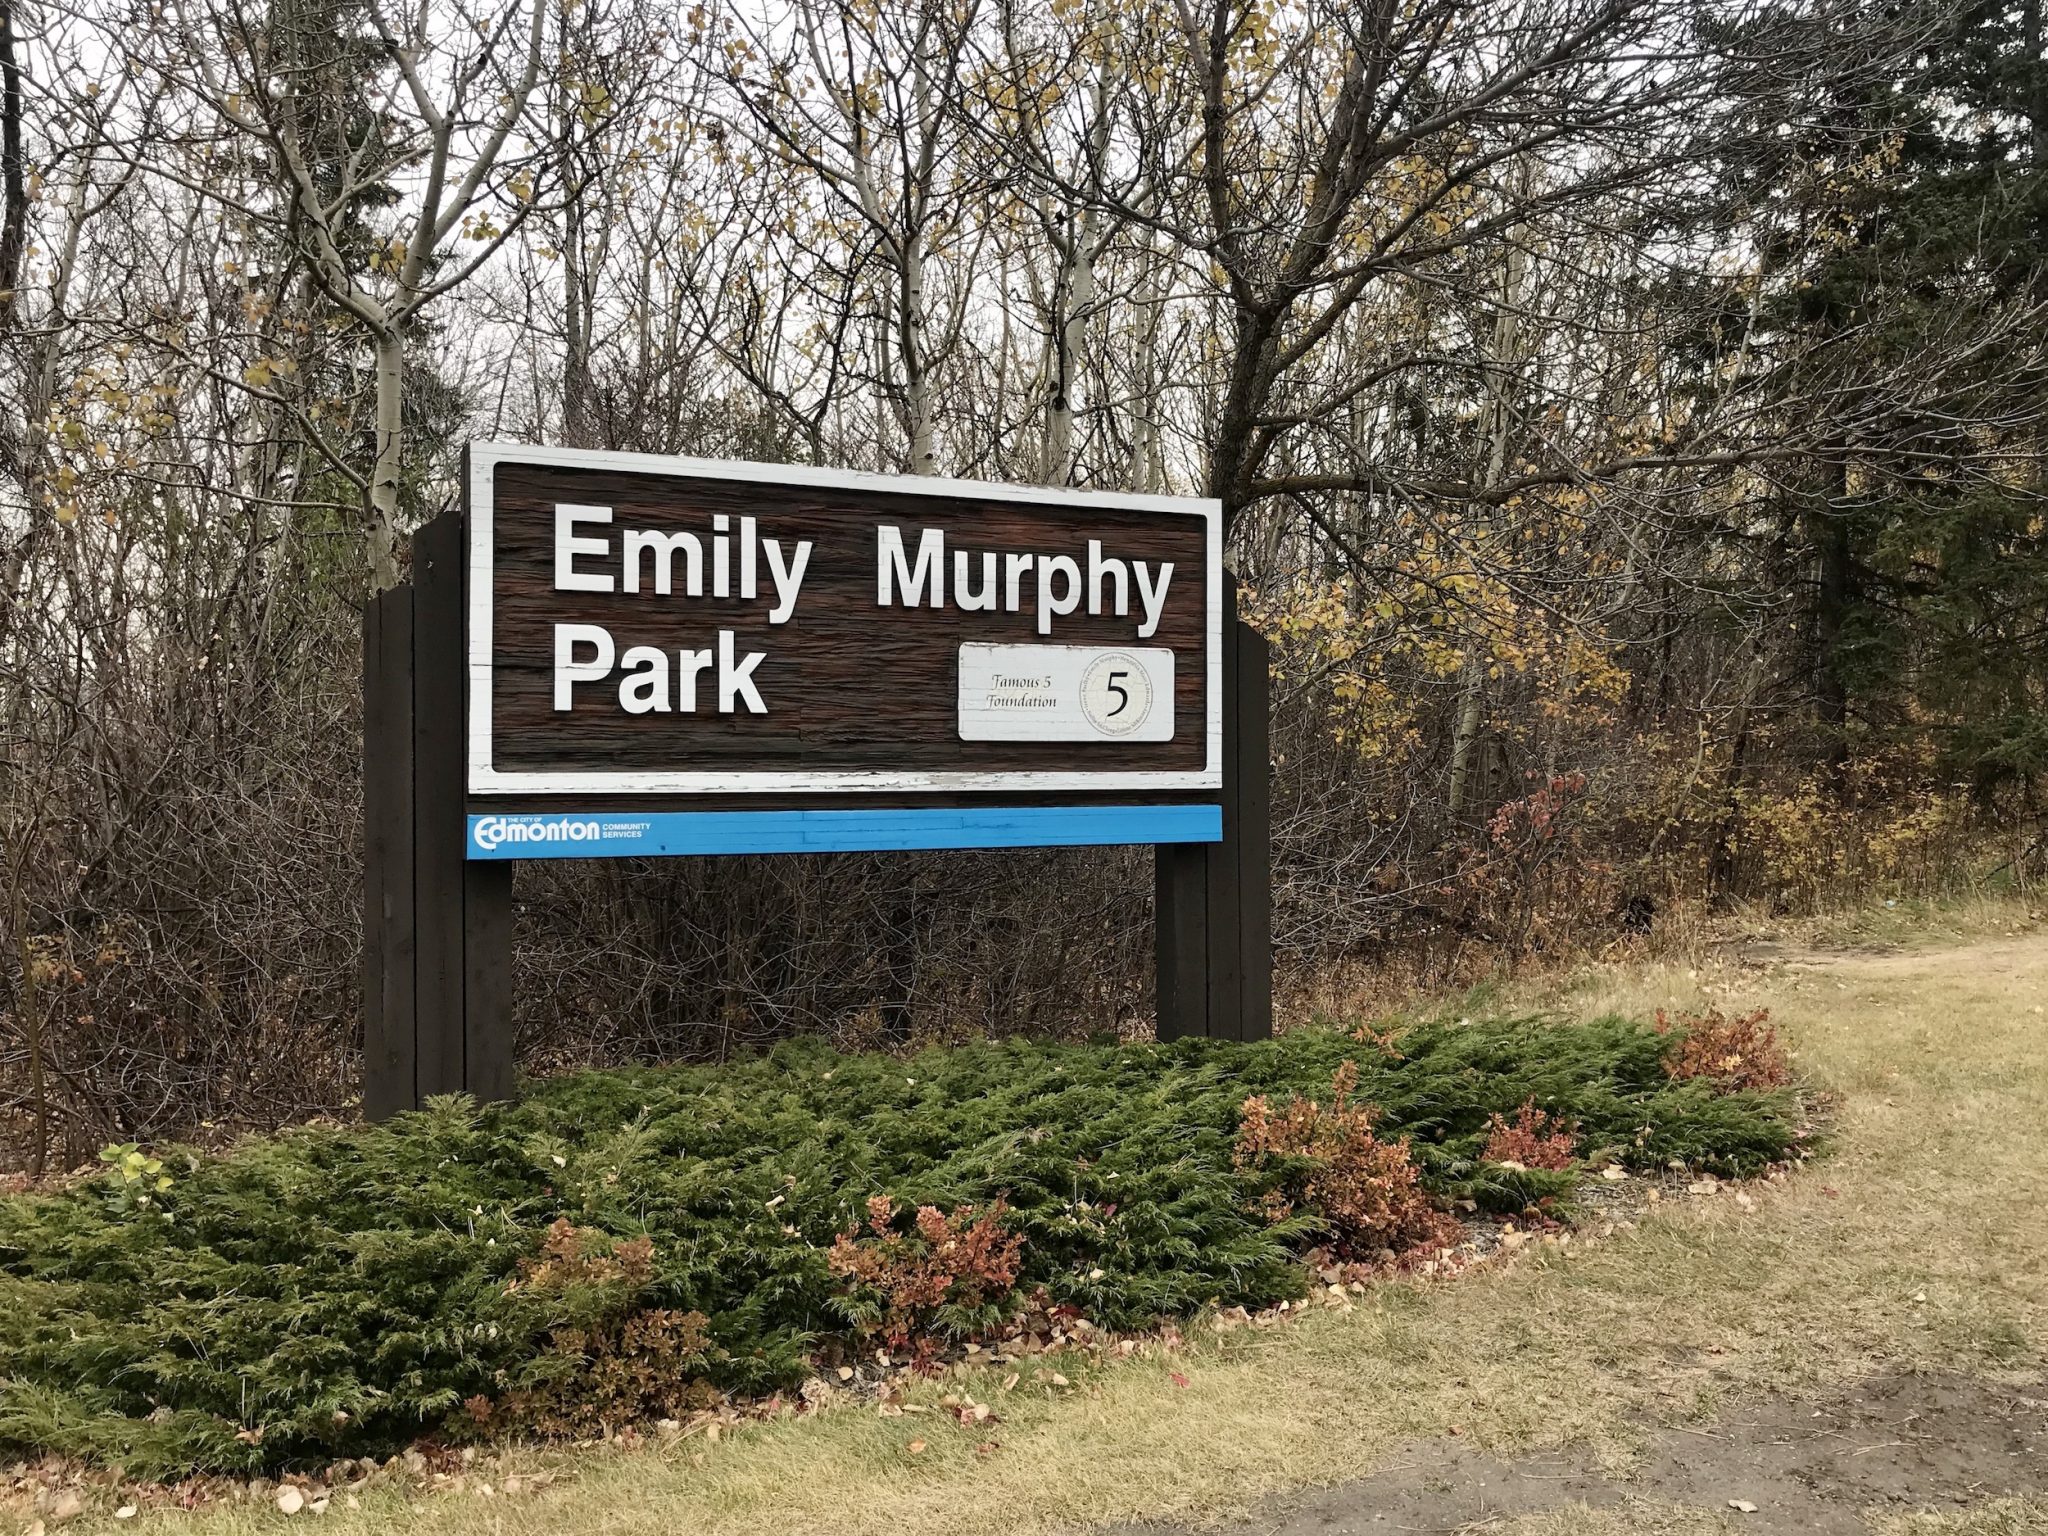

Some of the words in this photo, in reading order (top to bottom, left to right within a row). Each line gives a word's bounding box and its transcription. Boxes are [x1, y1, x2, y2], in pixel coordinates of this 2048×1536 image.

[553, 503, 813, 625] Emily
[876, 525, 1175, 638] Murphy
[553, 623, 768, 715] Park
[991, 674, 1039, 689] Famous
[1043, 675, 1051, 688] 5
[986, 692, 1057, 708] Foundation
[1107, 671, 1129, 717] 5
[474, 816, 600, 850] Edmonton
[602, 822, 651, 831] COMMUNITY
[602, 830, 642, 839] SERVICES
